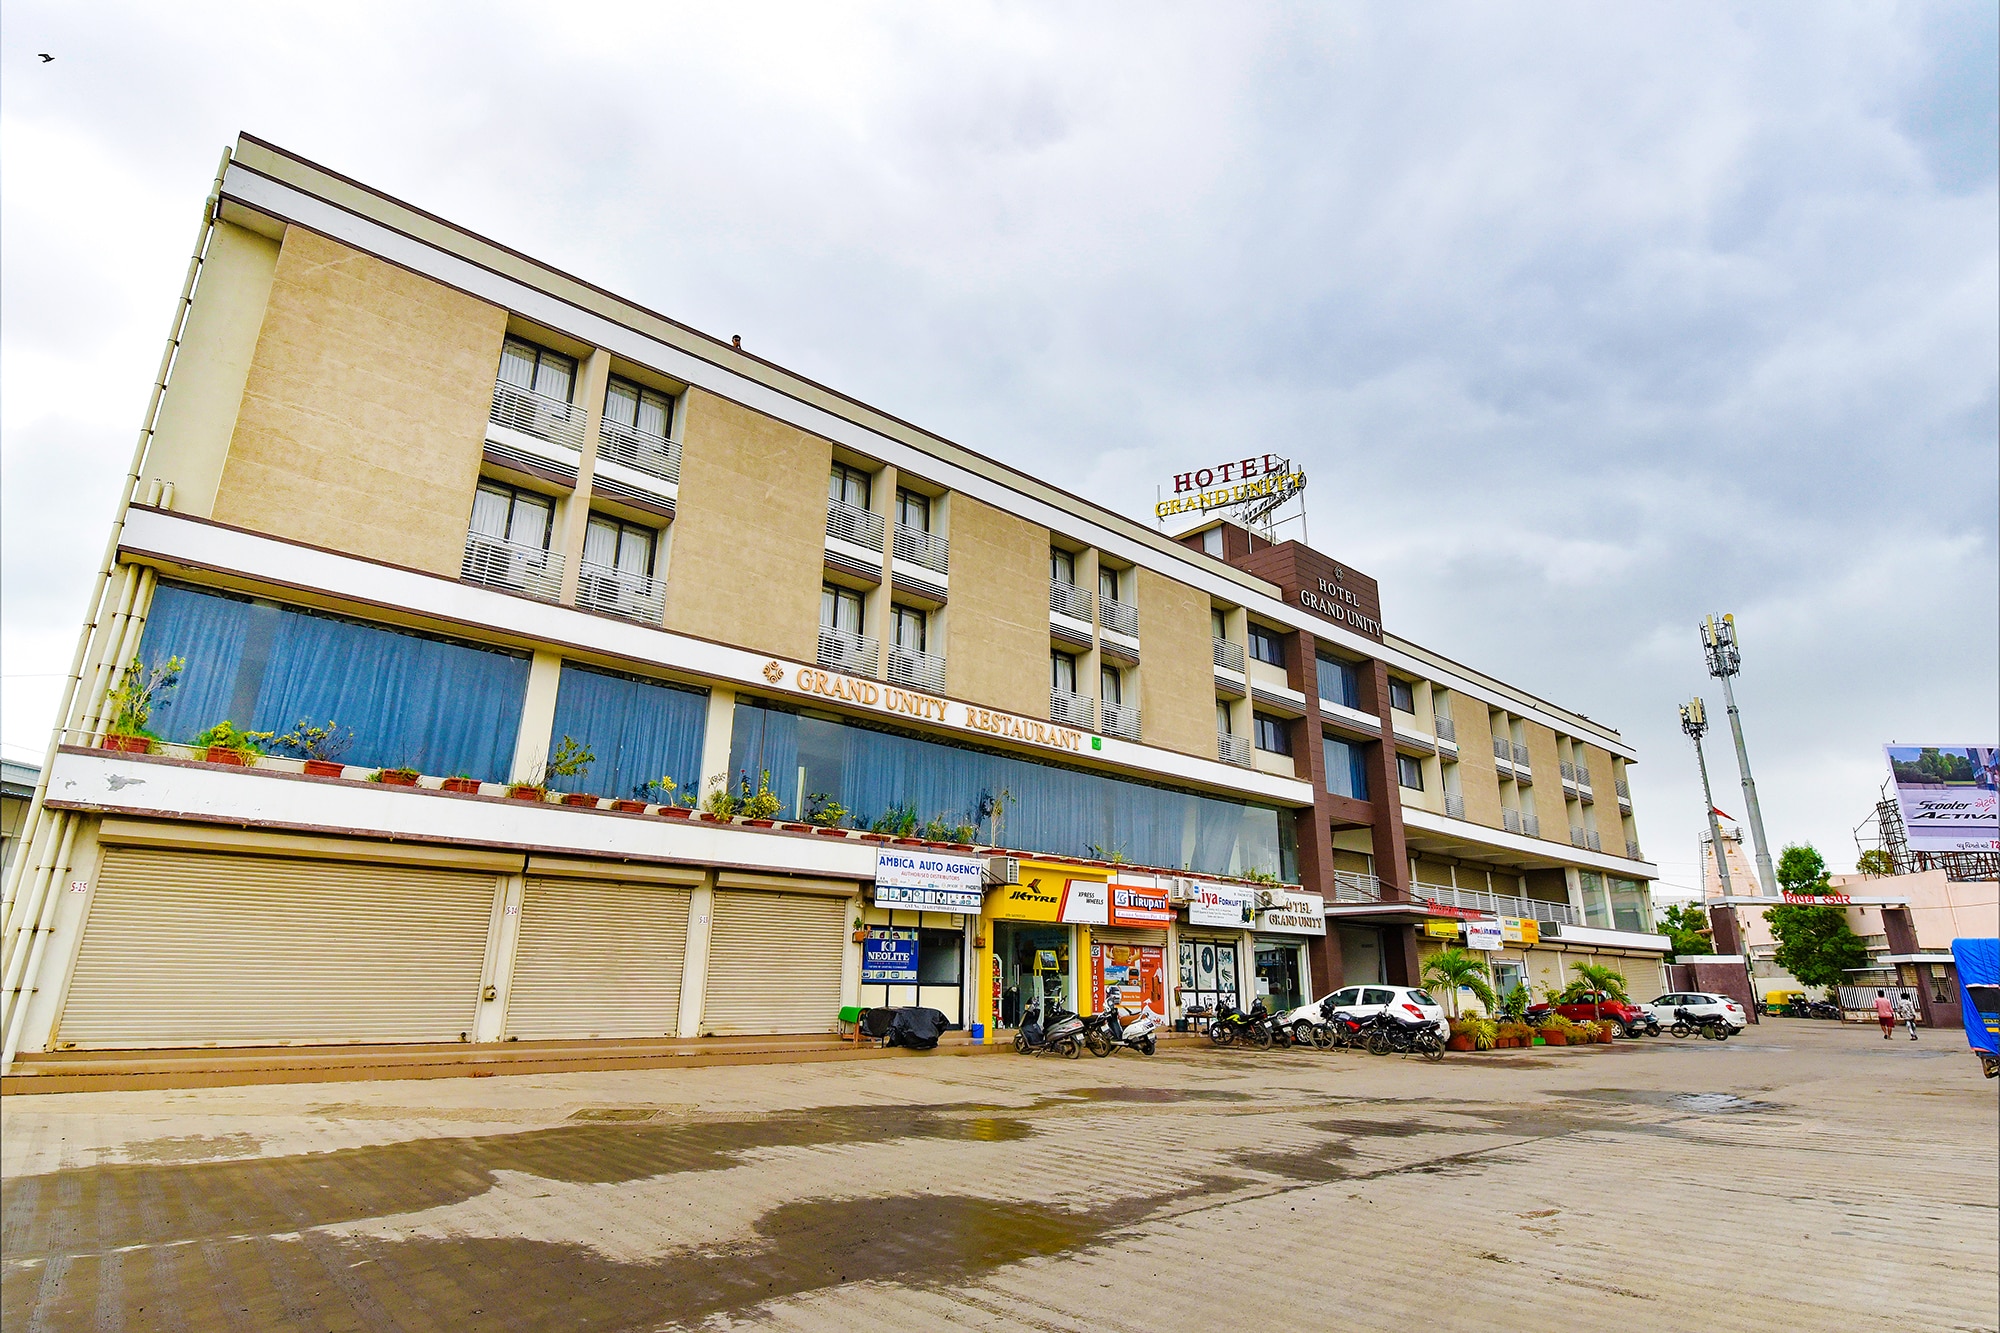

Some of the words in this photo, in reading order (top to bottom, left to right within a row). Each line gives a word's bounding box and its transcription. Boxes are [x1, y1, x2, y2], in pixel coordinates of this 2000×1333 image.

[1173, 454, 1281, 493] HOTEL
[1155, 488, 1229, 517] GRAND
[1233, 471, 1304, 501] UNITY
[1318, 577, 1360, 607] HOTEL
[1300, 589, 1345, 621] GRAND
[1347, 609, 1381, 637] UNITY
[797, 668, 879, 705] GRAND
[885, 688, 949, 721] UNITY
[965, 707, 1082, 750] RESTAURANT
[1912, 811, 1997, 819] ACTIVA
[879, 856, 915, 869] AMBICA
[919, 860, 944, 872] AUTO
[946, 863, 981, 875] AGENCY
[901, 870, 930, 878] AUTHORISED
[930, 873, 960, 881] DISTRIBUTORS
[71, 882, 87, 892] S-15
[1197, 888, 1218, 908] iya
[1219, 897, 1242, 907] FORKLIFT
[1279, 899, 1312, 914] OTEL
[1269, 913, 1297, 927] GRAND
[1298, 916, 1322, 929] UNITY
[867, 951, 910, 961] NEOLITE
